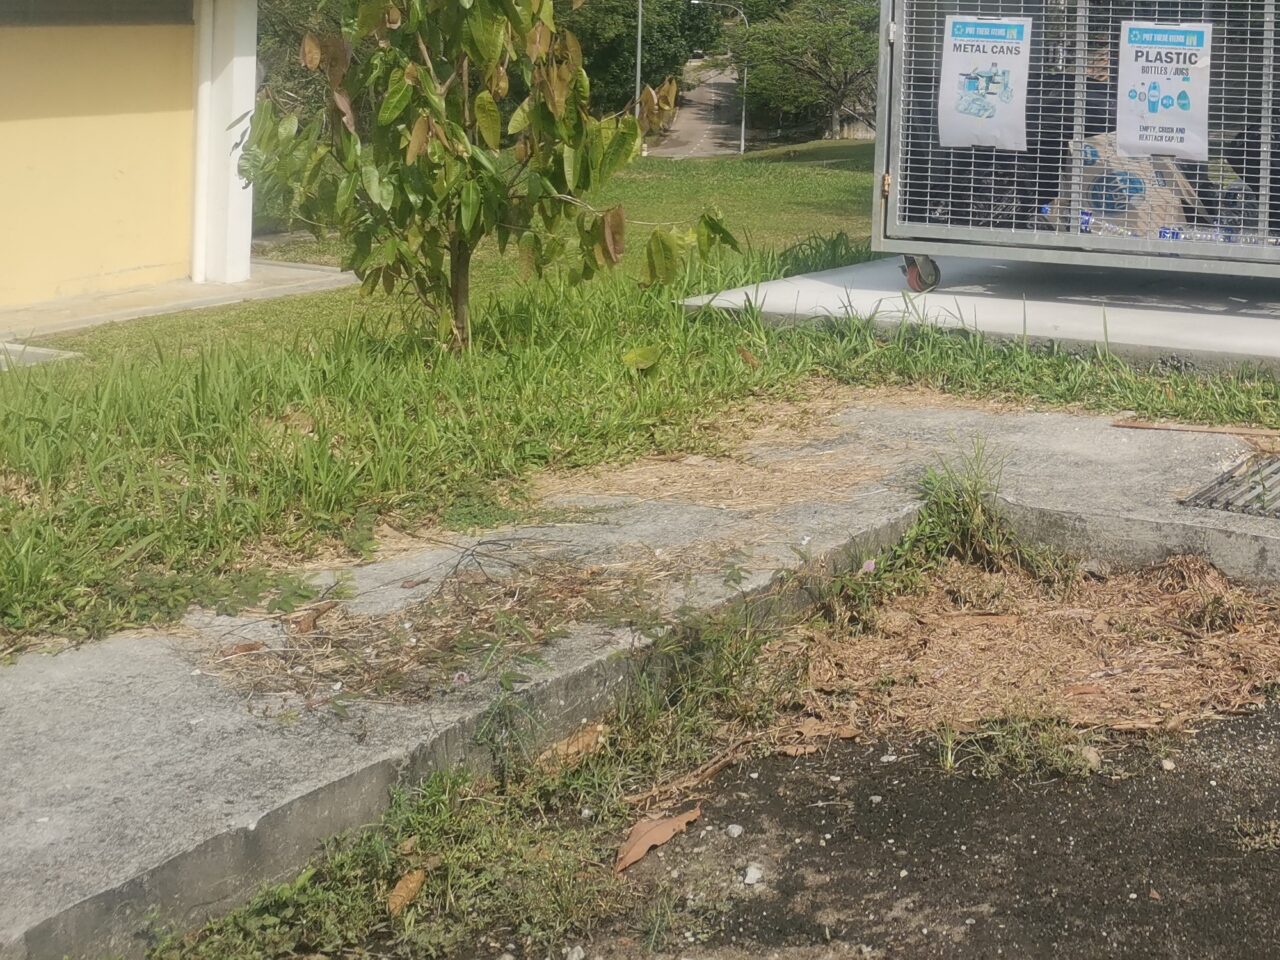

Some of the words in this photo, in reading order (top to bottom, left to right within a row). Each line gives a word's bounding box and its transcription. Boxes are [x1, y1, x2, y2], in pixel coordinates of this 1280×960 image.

[953, 43, 988, 53] METAL
[991, 45, 1021, 56] CANS
[1134, 50, 1198, 65] PLASTIC
[1141, 65, 1168, 75] BOTTLES
